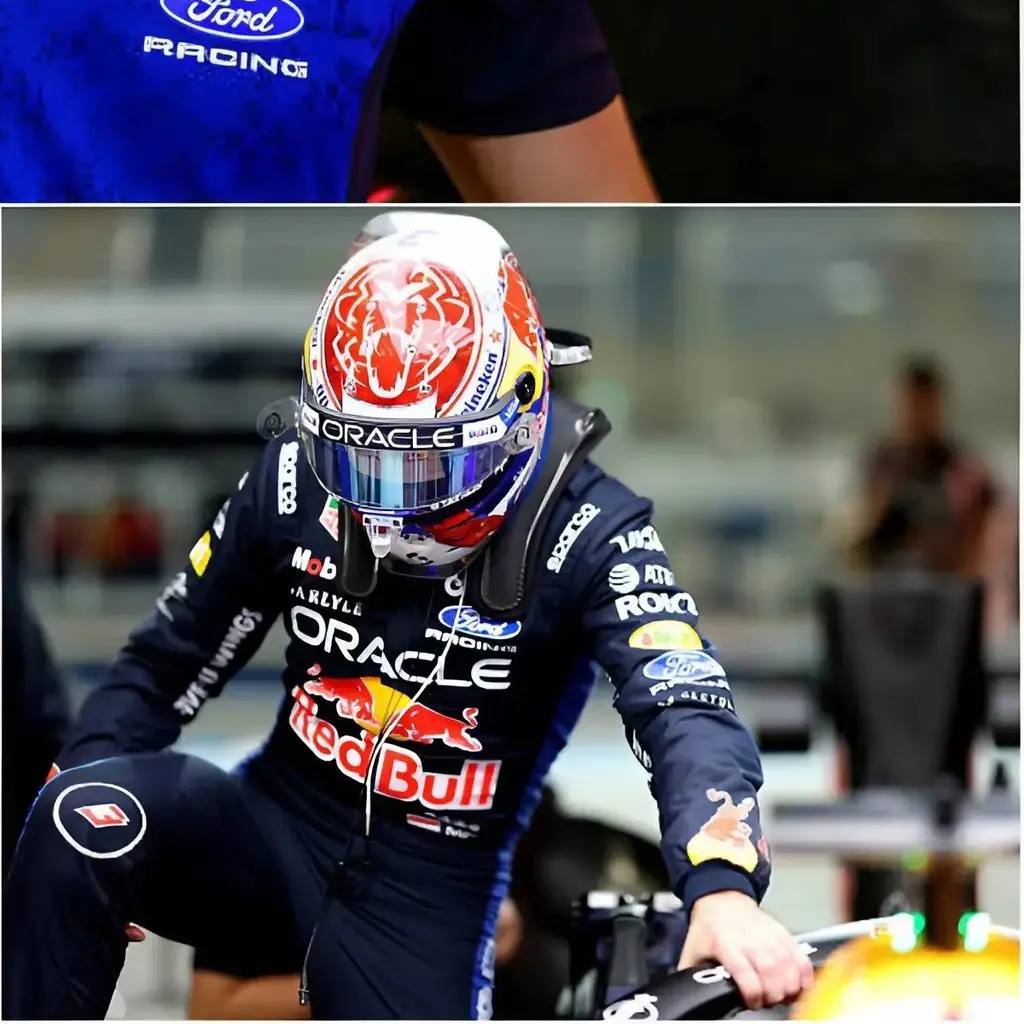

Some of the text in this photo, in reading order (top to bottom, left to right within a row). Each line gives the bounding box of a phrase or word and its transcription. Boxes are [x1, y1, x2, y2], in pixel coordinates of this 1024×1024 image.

[143, 35, 308, 79] RACING
[322, 420, 455, 449] ORACLE
[291, 546, 337, 580] Mob
[290, 586, 363, 616] ARLYLE
[291, 605, 512, 690] ORACLE
[373, 742, 502, 811] Bull
